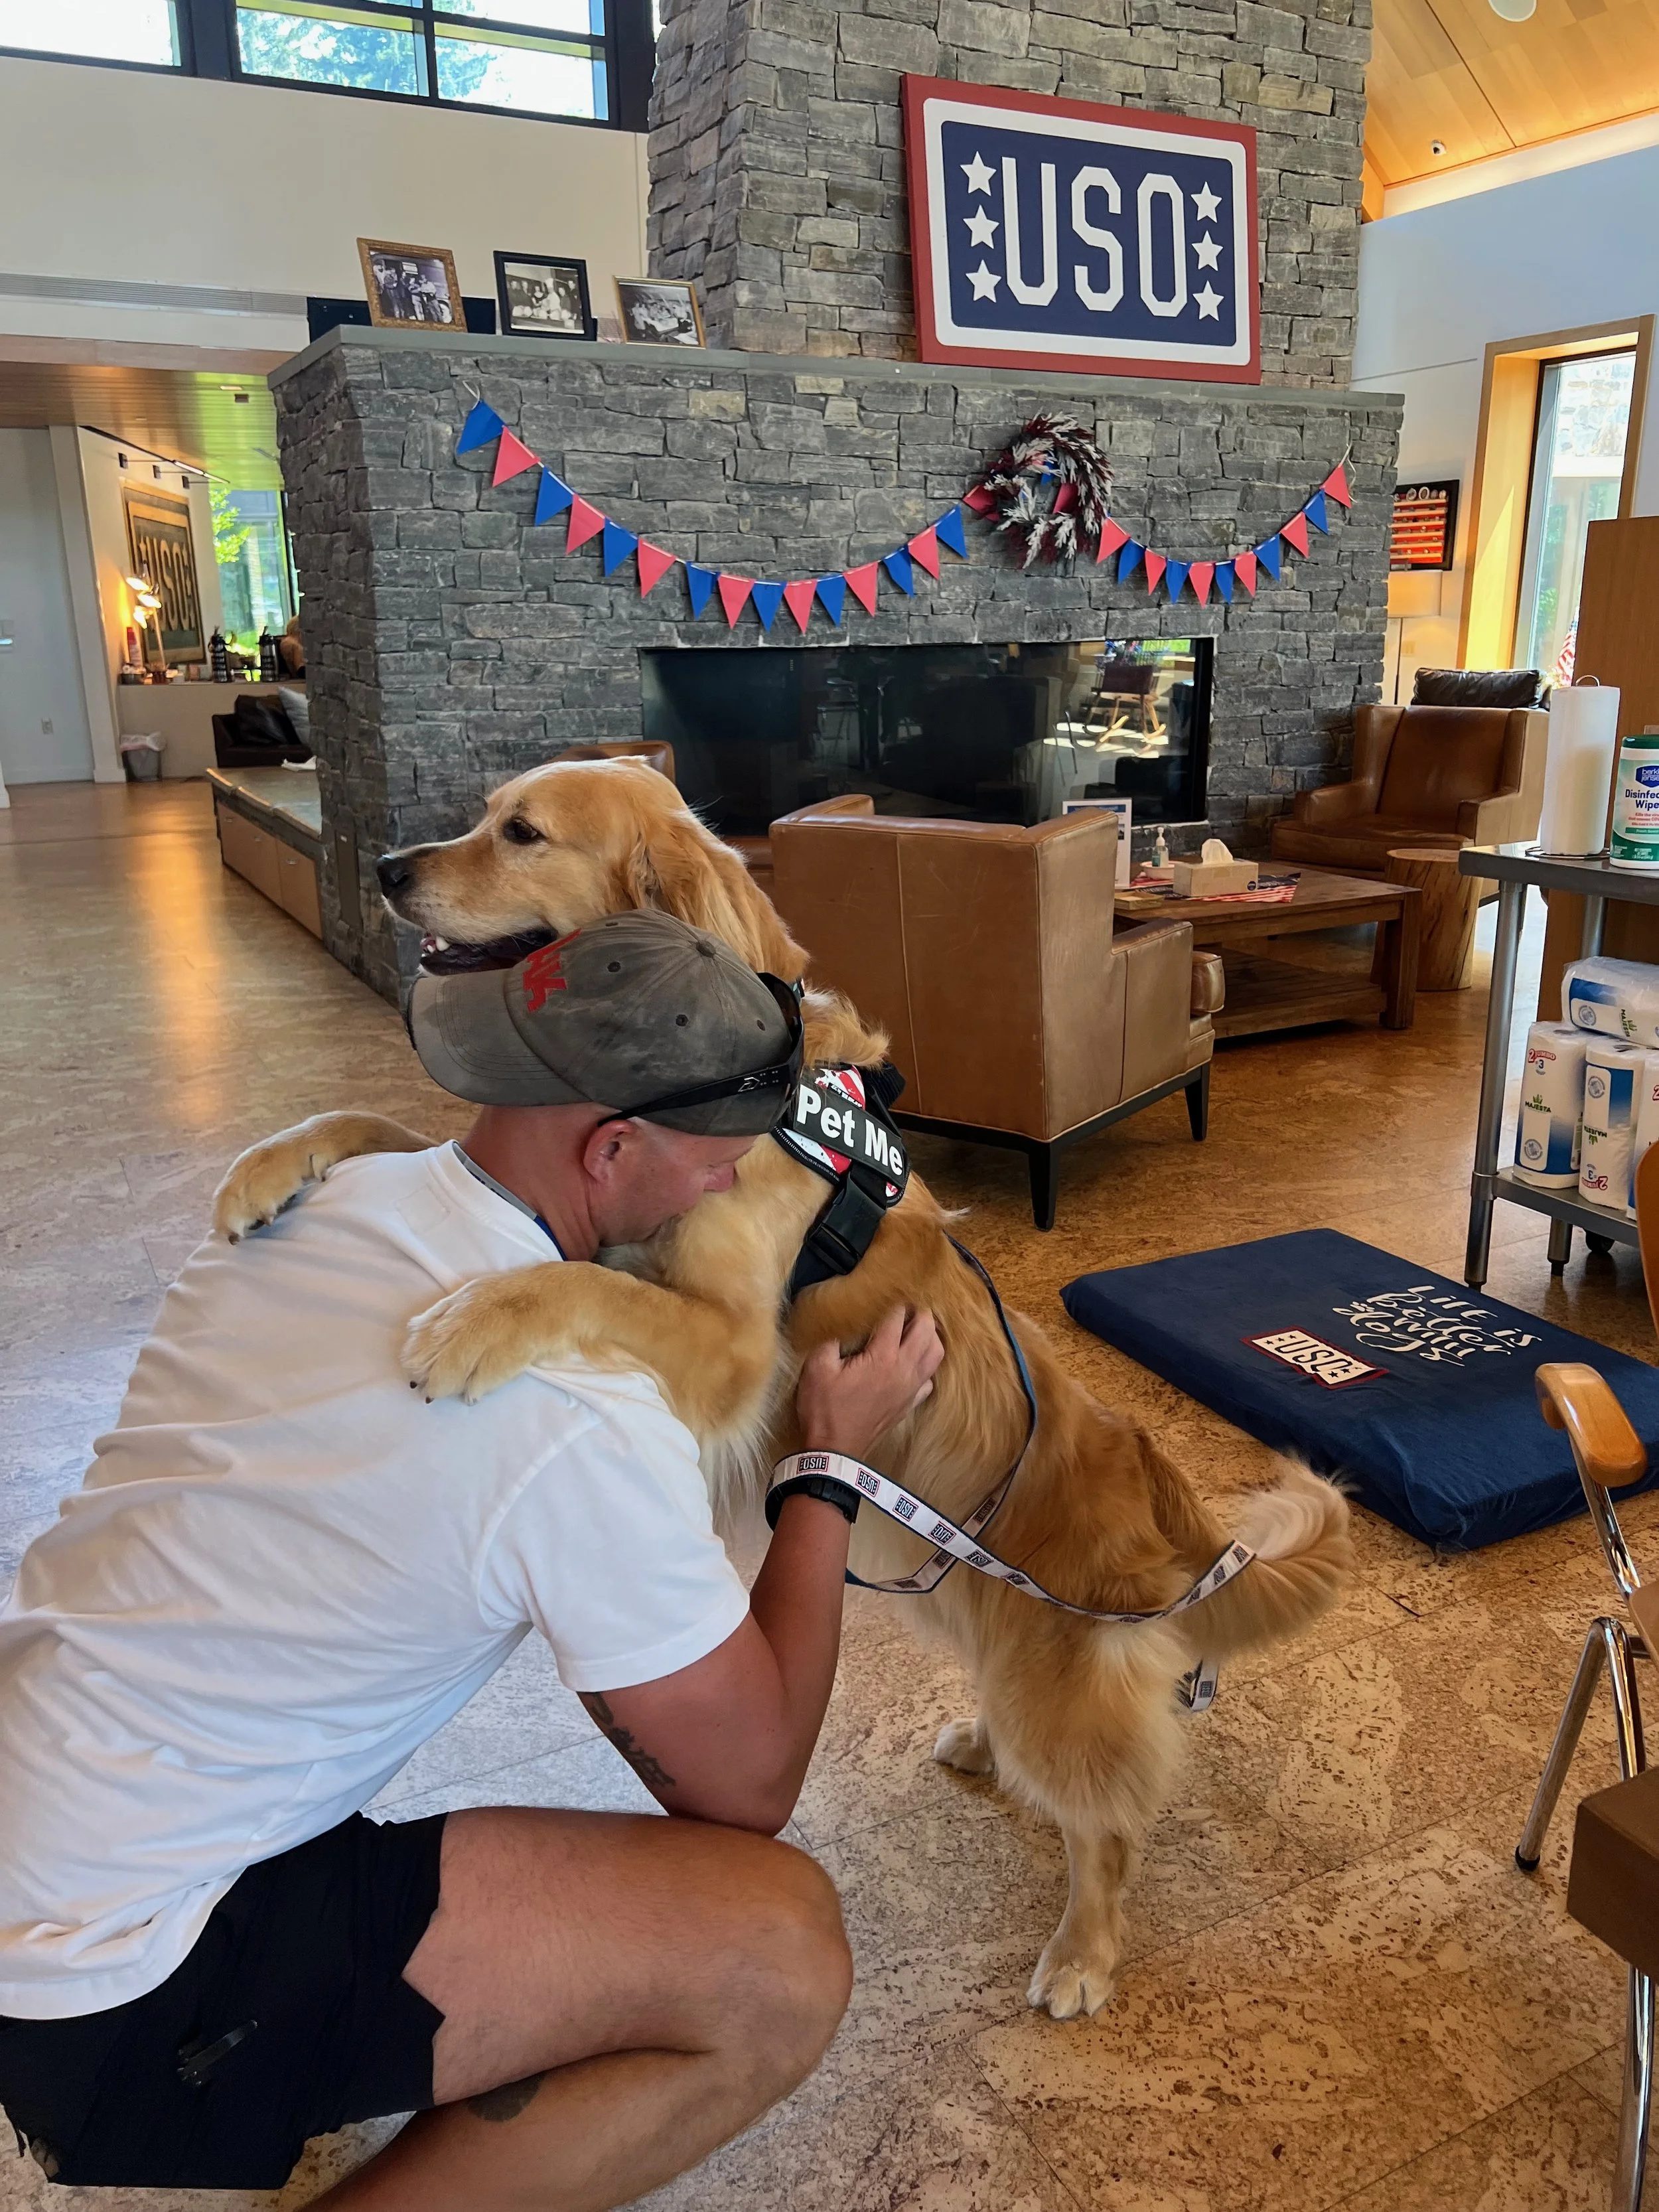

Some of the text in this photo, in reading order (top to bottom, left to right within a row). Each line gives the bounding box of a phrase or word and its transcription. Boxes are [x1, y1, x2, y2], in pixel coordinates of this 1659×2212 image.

[1002, 157, 1187, 317] USO
[1636, 800, 1659, 811] Wipe
[1524, 1100, 1551, 1113] MAJESTA
[796, 1084, 904, 1176] Pet Me
[1275, 1339, 1353, 1372] USO
[803, 1457, 822, 1469] USO
[861, 1474, 875, 1493] USO
[899, 1500, 913, 1518] USO
